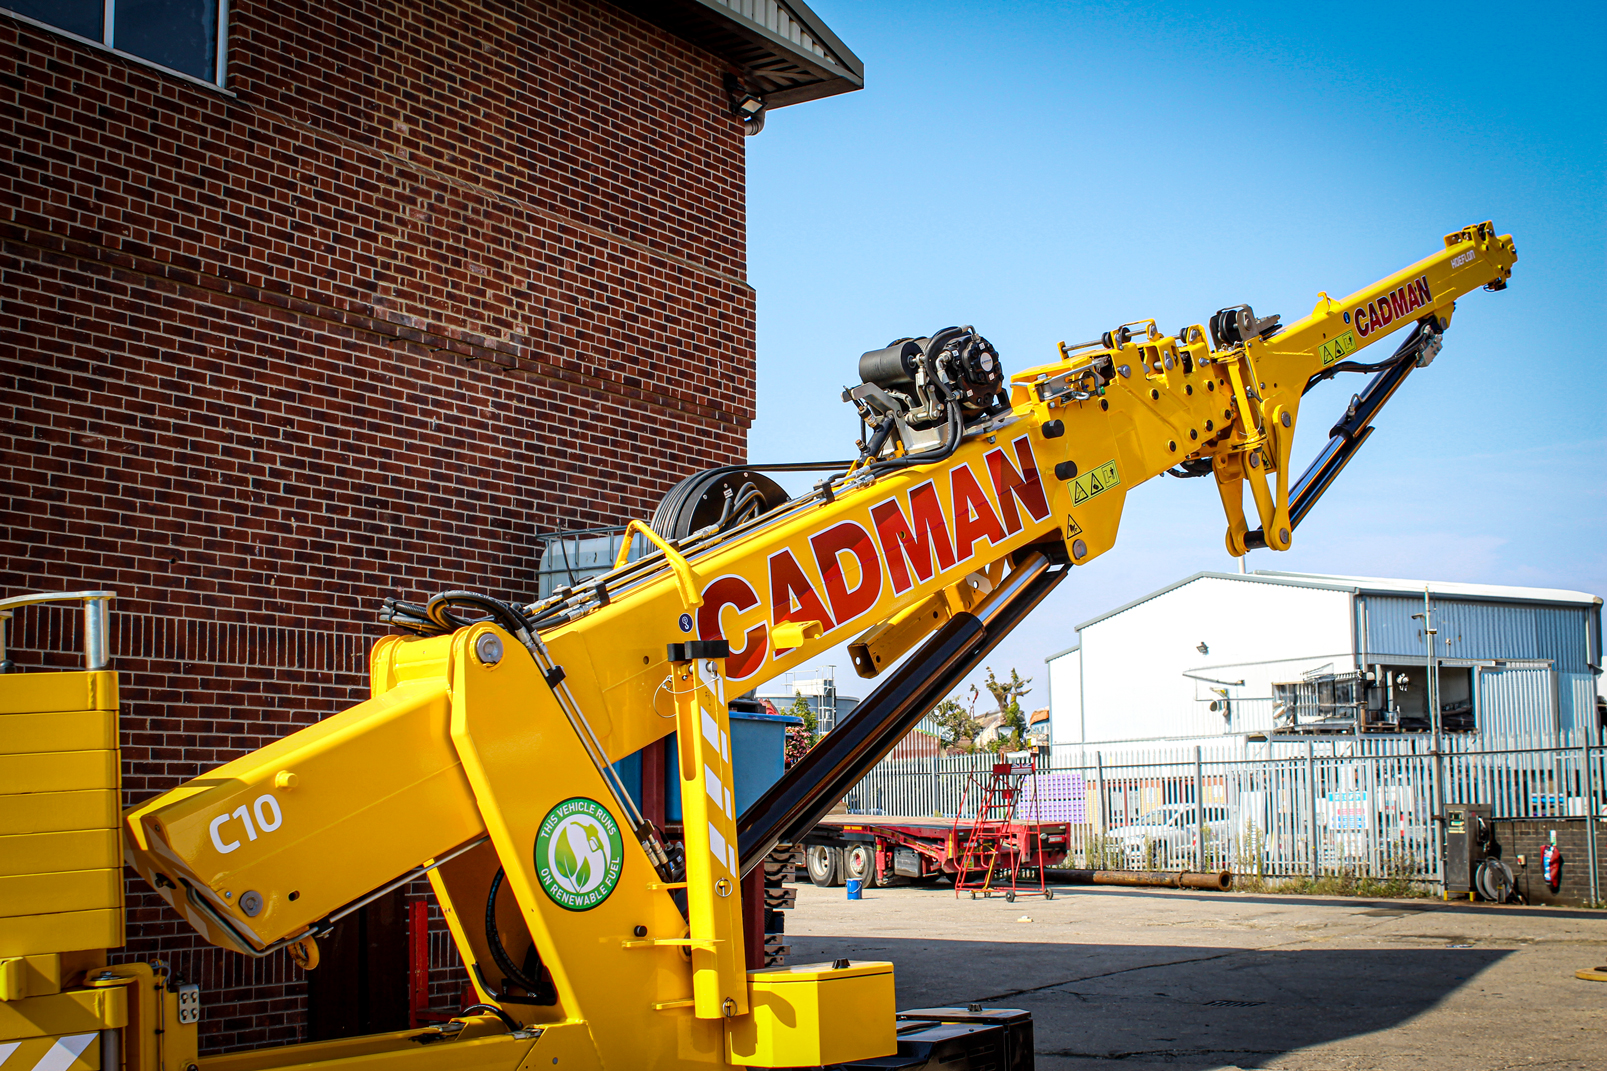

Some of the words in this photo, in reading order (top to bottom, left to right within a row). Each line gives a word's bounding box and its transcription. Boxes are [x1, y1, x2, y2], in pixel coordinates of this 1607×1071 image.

[1451, 250, 1476, 269] HOEFLON
[1354, 275, 1433, 337] CADMAN
[696, 433, 1052, 680] CADMAN
[209, 794, 283, 854] C10
[541, 815, 558, 838] THIS
[556, 802, 596, 818] VEHICLE
[596, 809, 617, 836] RUNS
[541, 868, 553, 885] ON
[550, 885, 608, 906] RENEWABLE
[605, 857, 620, 887] FUEL
